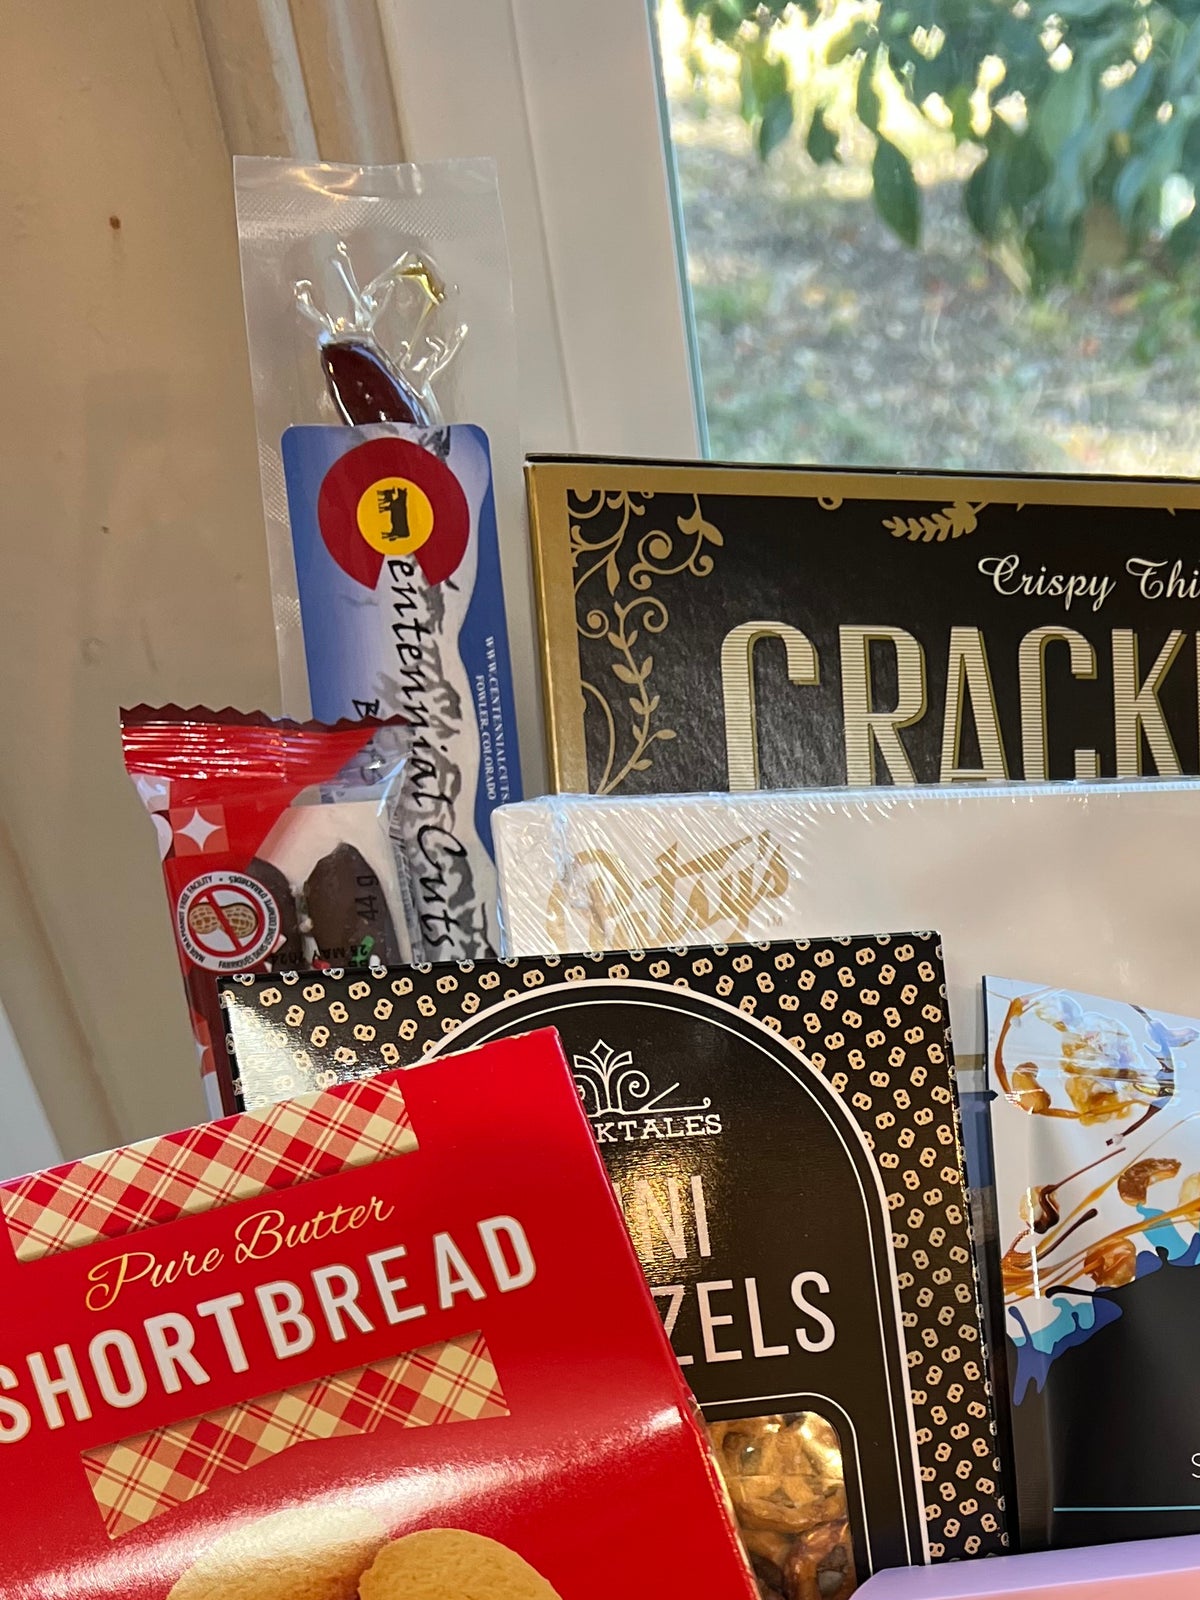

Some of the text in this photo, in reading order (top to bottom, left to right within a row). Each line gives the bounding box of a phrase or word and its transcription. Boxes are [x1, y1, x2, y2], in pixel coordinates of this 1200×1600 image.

[977, 555, 1116, 611] Crispy
[481, 731, 498, 801] COLORADO
[416, 822, 468, 950] Cuts
[85, 1194, 394, 1312] Pure Butter
[0, 1214, 538, 1443] SHORTBREAD
